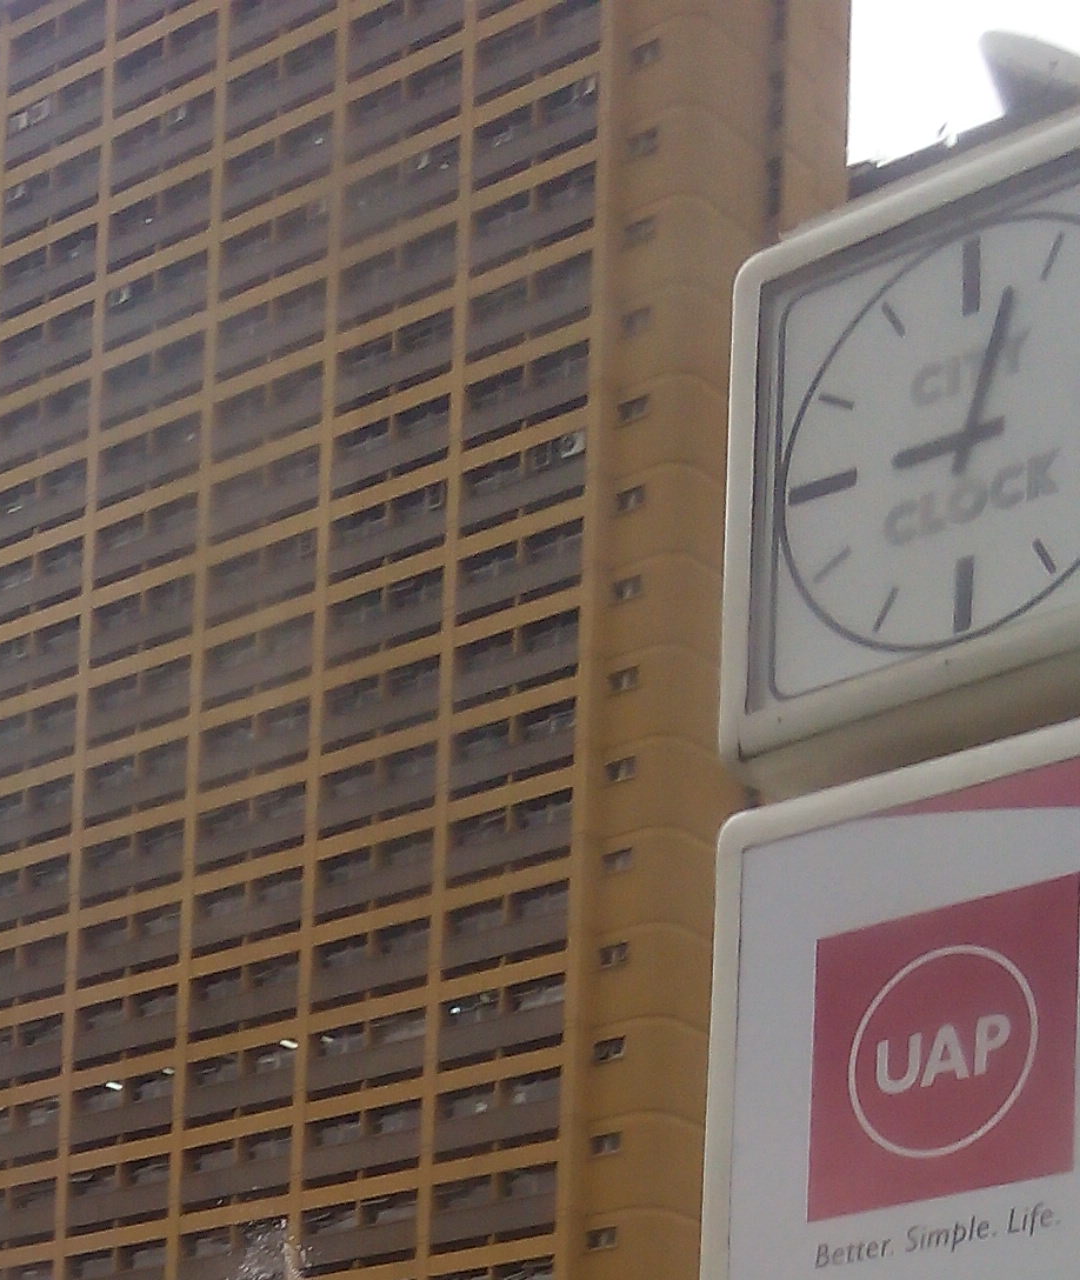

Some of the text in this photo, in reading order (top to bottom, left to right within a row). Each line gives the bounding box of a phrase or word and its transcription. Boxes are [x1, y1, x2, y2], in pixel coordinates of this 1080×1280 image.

[883, 447, 1060, 547] CLOCK
[875, 1013, 1011, 1095] UAP
[815, 1201, 1061, 1270] Better. Simple. Life.
